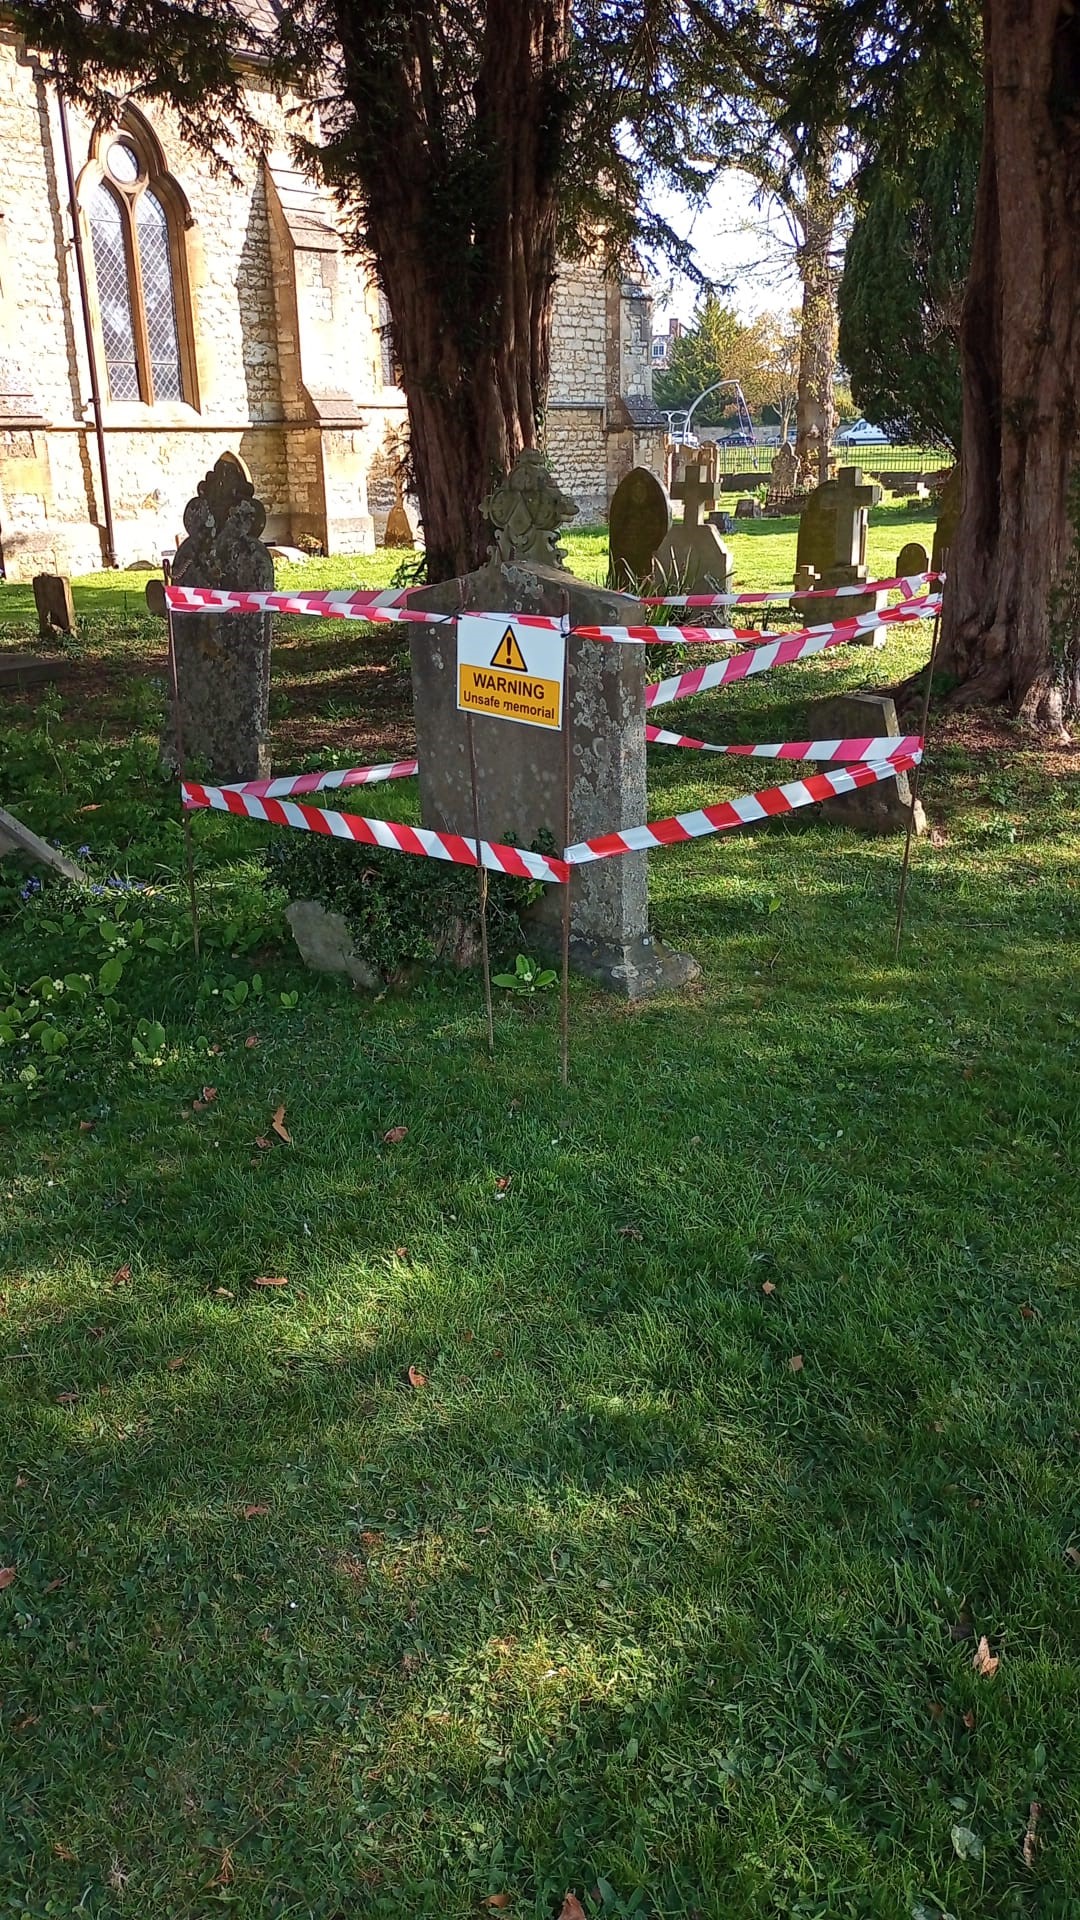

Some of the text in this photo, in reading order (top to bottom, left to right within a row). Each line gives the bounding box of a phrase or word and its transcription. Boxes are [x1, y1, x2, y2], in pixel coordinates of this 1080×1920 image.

[473, 672, 544, 699] WARNING
[463, 690, 555, 719] Unsafe memorial
